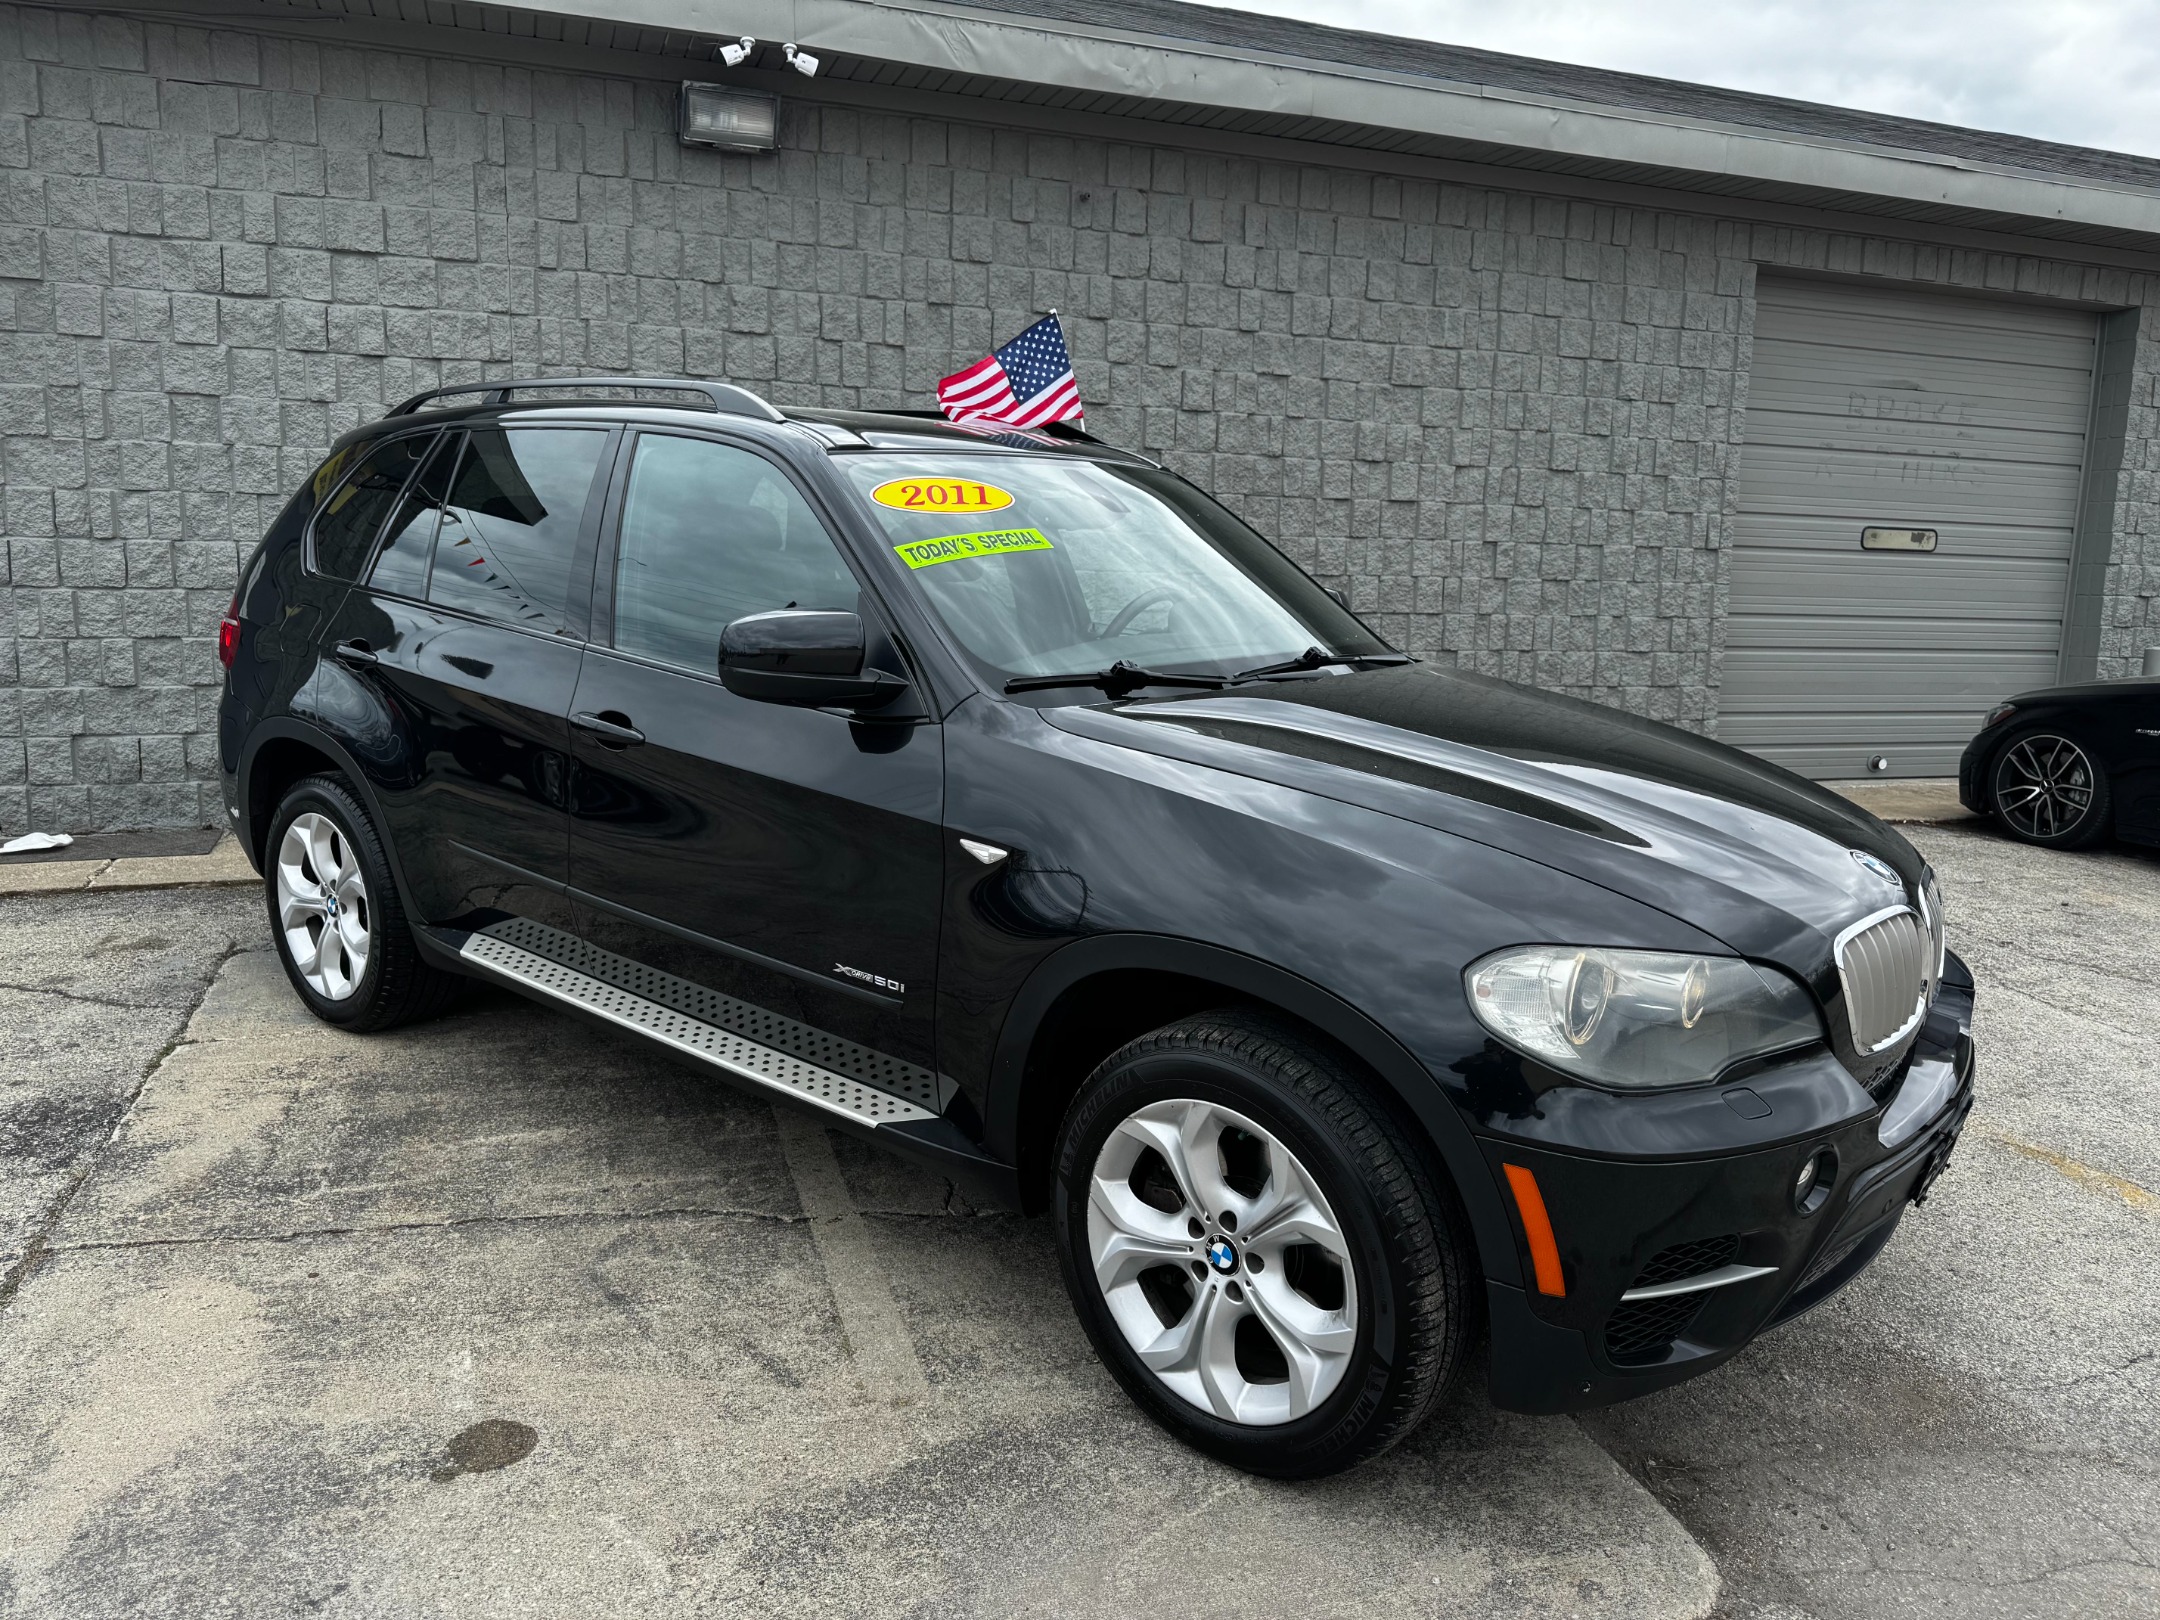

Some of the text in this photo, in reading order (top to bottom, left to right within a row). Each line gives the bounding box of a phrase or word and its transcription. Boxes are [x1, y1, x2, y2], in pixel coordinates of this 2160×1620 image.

[900, 484, 993, 507] 2011
[904, 531, 1045, 564] TODAY'S SPECIAL
[1067, 1069, 1134, 1149] MICHELIN
